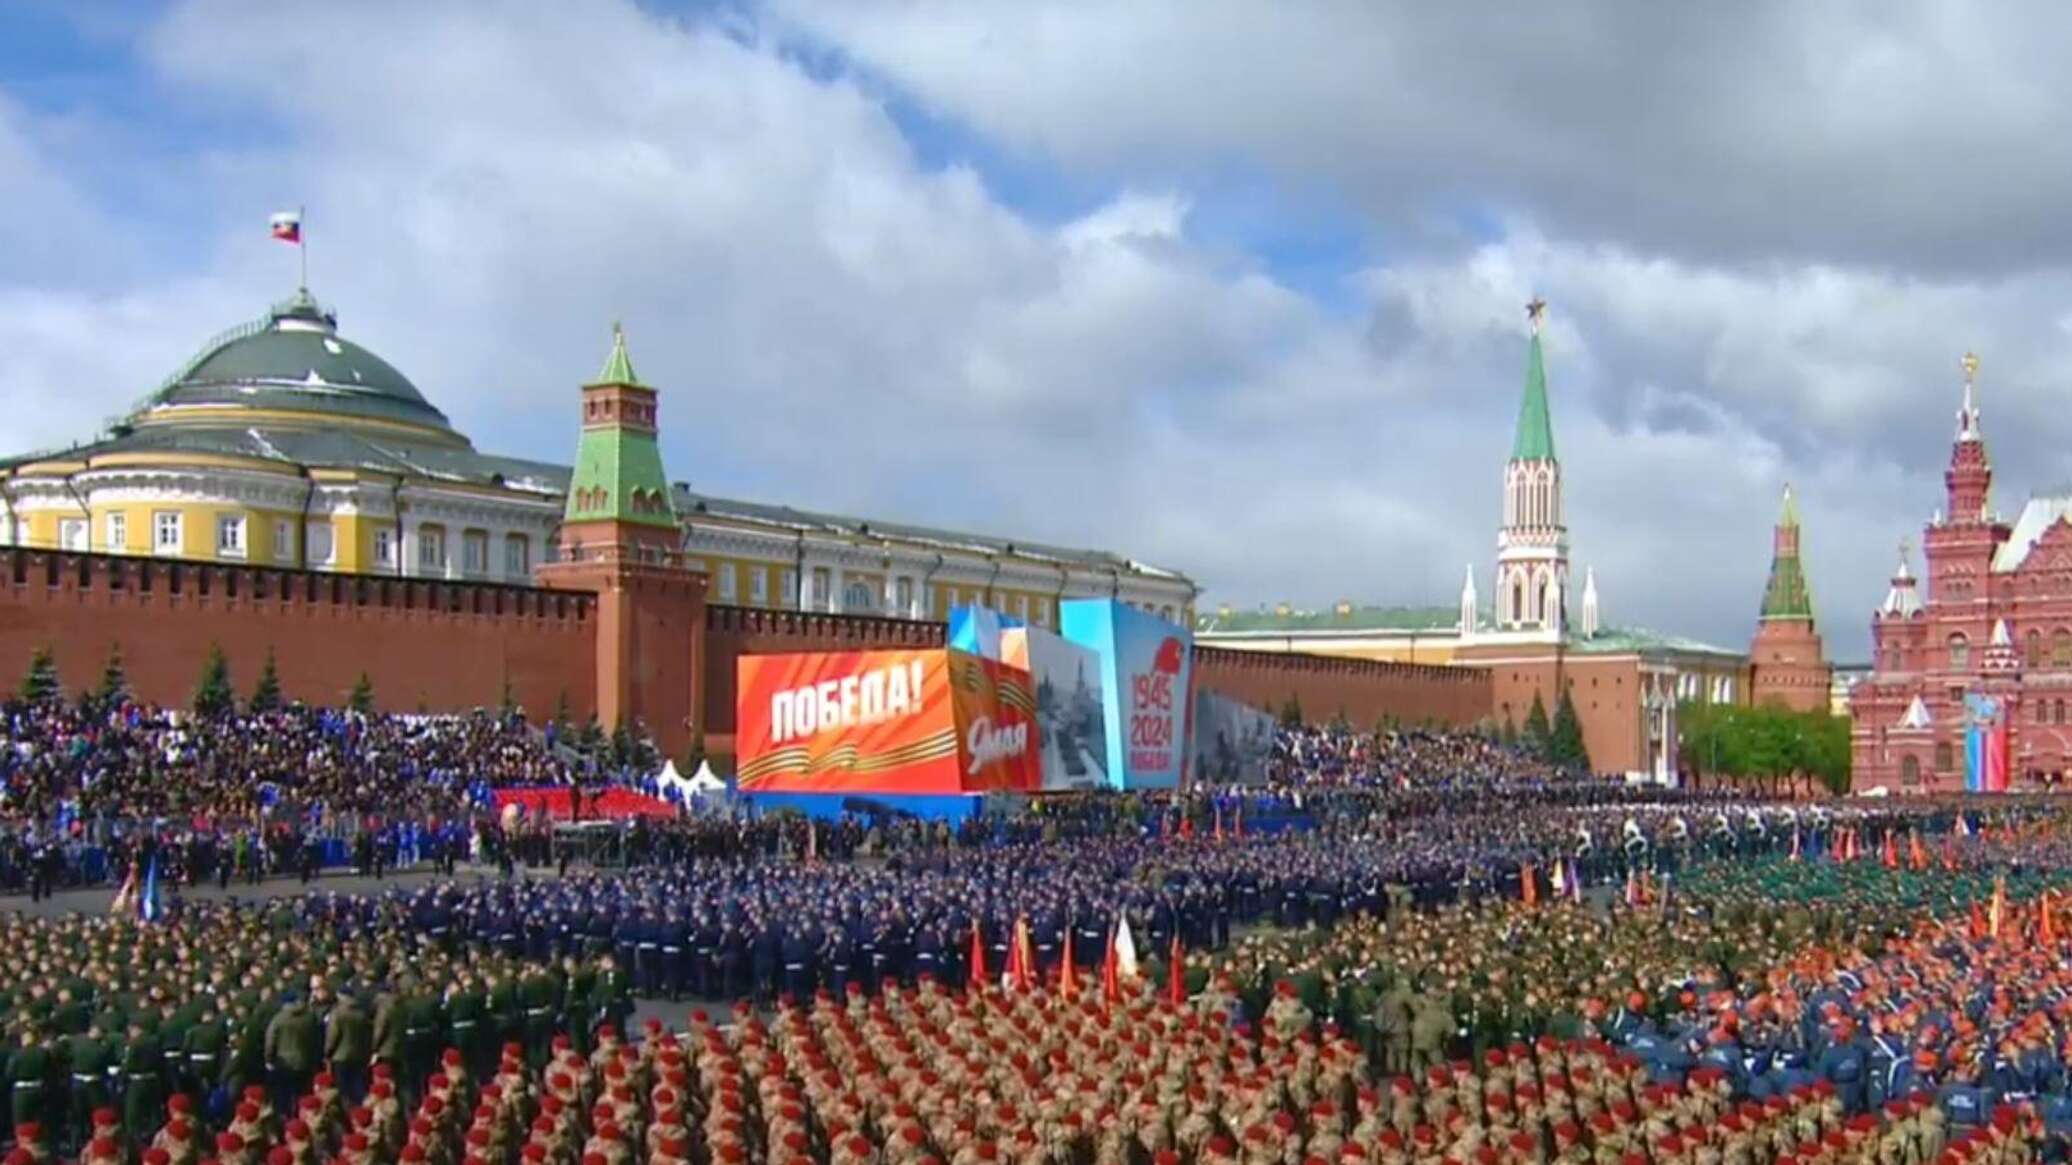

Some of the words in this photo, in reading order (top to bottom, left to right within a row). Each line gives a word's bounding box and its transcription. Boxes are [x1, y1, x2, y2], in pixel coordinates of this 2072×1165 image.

[771, 659, 923, 742] ПОБЕДА!
[1131, 673, 1172, 709] 1945
[1130, 714, 1172, 746] 2024
